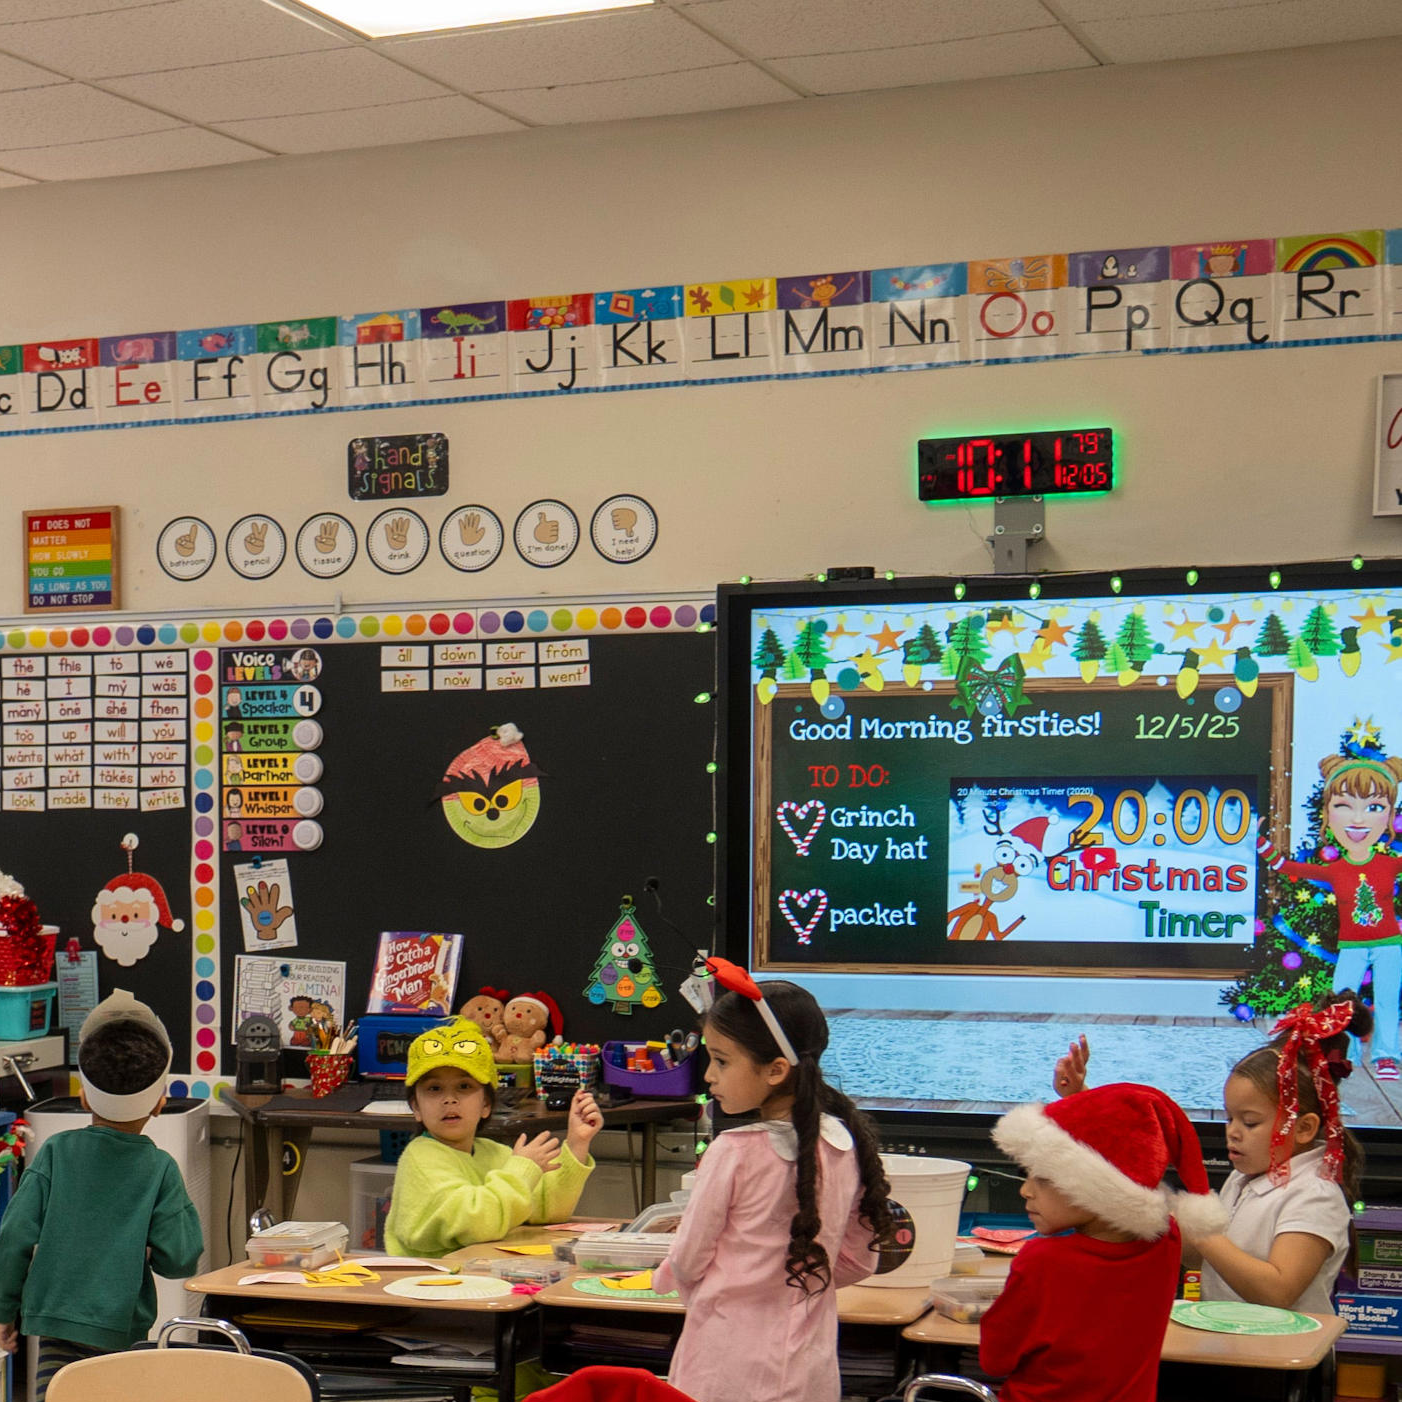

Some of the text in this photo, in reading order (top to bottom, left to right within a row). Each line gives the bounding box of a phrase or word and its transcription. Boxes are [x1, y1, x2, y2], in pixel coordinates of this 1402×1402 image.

[1298, 270, 1361, 318] Rr
[979, 291, 1054, 338] Oo
[1087, 285, 1150, 350] Pp
[1176, 279, 1269, 344] Qq
[711, 313, 751, 360] Ll
[785, 307, 863, 355] Mm
[613, 322, 666, 366] Kk
[353, 344, 405, 387] Hh
[453, 336, 476, 379] Ii
[526, 329, 577, 390] Jj
[115, 365, 161, 406] Ee
[193, 357, 244, 400] Ff
[267, 352, 329, 407] Gg
[375, 445, 422, 469] hand
[957, 438, 1062, 495] 10:11
[1063, 463, 1107, 486] 12/05
[360, 469, 435, 494] signals
[33, 518, 91, 530] IT DOES NOT
[33, 536, 67, 545] MATTER
[545, 543, 568, 552] done!
[388, 551, 409, 560] drink
[454, 548, 491, 559] question
[616, 547, 636, 556] help!
[244, 557, 270, 567] pencil
[313, 556, 341, 565] tissue
[34, 581, 107, 592] AS LONG AS YOU
[33, 594, 94, 605] DO NOT STOP
[232, 652, 275, 667] Voice
[398, 649, 412, 662] all
[440, 648, 476, 661] down
[496, 646, 525, 661] four
[546, 644, 583, 659] from
[227, 665, 282, 681] LEVELS
[497, 676, 524, 686] saw
[548, 670, 582, 683] went
[242, 702, 292, 716] Speaker
[300, 691, 314, 711] 4
[789, 712, 1241, 744] Good Morning firsties! 12/5/25
[249, 736, 288, 748] Group
[55, 750, 85, 762] what
[808, 764, 890, 789] TO DO:
[957, 787, 1093, 797] 20 Minute Christmas Timer (2020)
[244, 803, 294, 817] Whisper
[830, 805, 915, 828] Grinch
[1068, 788, 1250, 846] 20:00
[251, 836, 285, 848] Silent
[830, 834, 927, 865] Day hat
[1047, 855, 1248, 891] Christmas
[829, 903, 916, 931] packet
[1139, 901, 1246, 937] Timer
[389, 941, 411, 953] How
[385, 947, 431, 965] to Catch a
[308, 965, 340, 974] BUILDING
[375, 956, 436, 993] Gingerbread
[303, 974, 332, 983] READING
[283, 981, 341, 997] STAMINA!
[392, 979, 423, 1002] Man
[542, 1075, 579, 1084] highlighters
[1339, 1304, 1398, 1317] Word Family
[1358, 1314, 1388, 1322] Books
